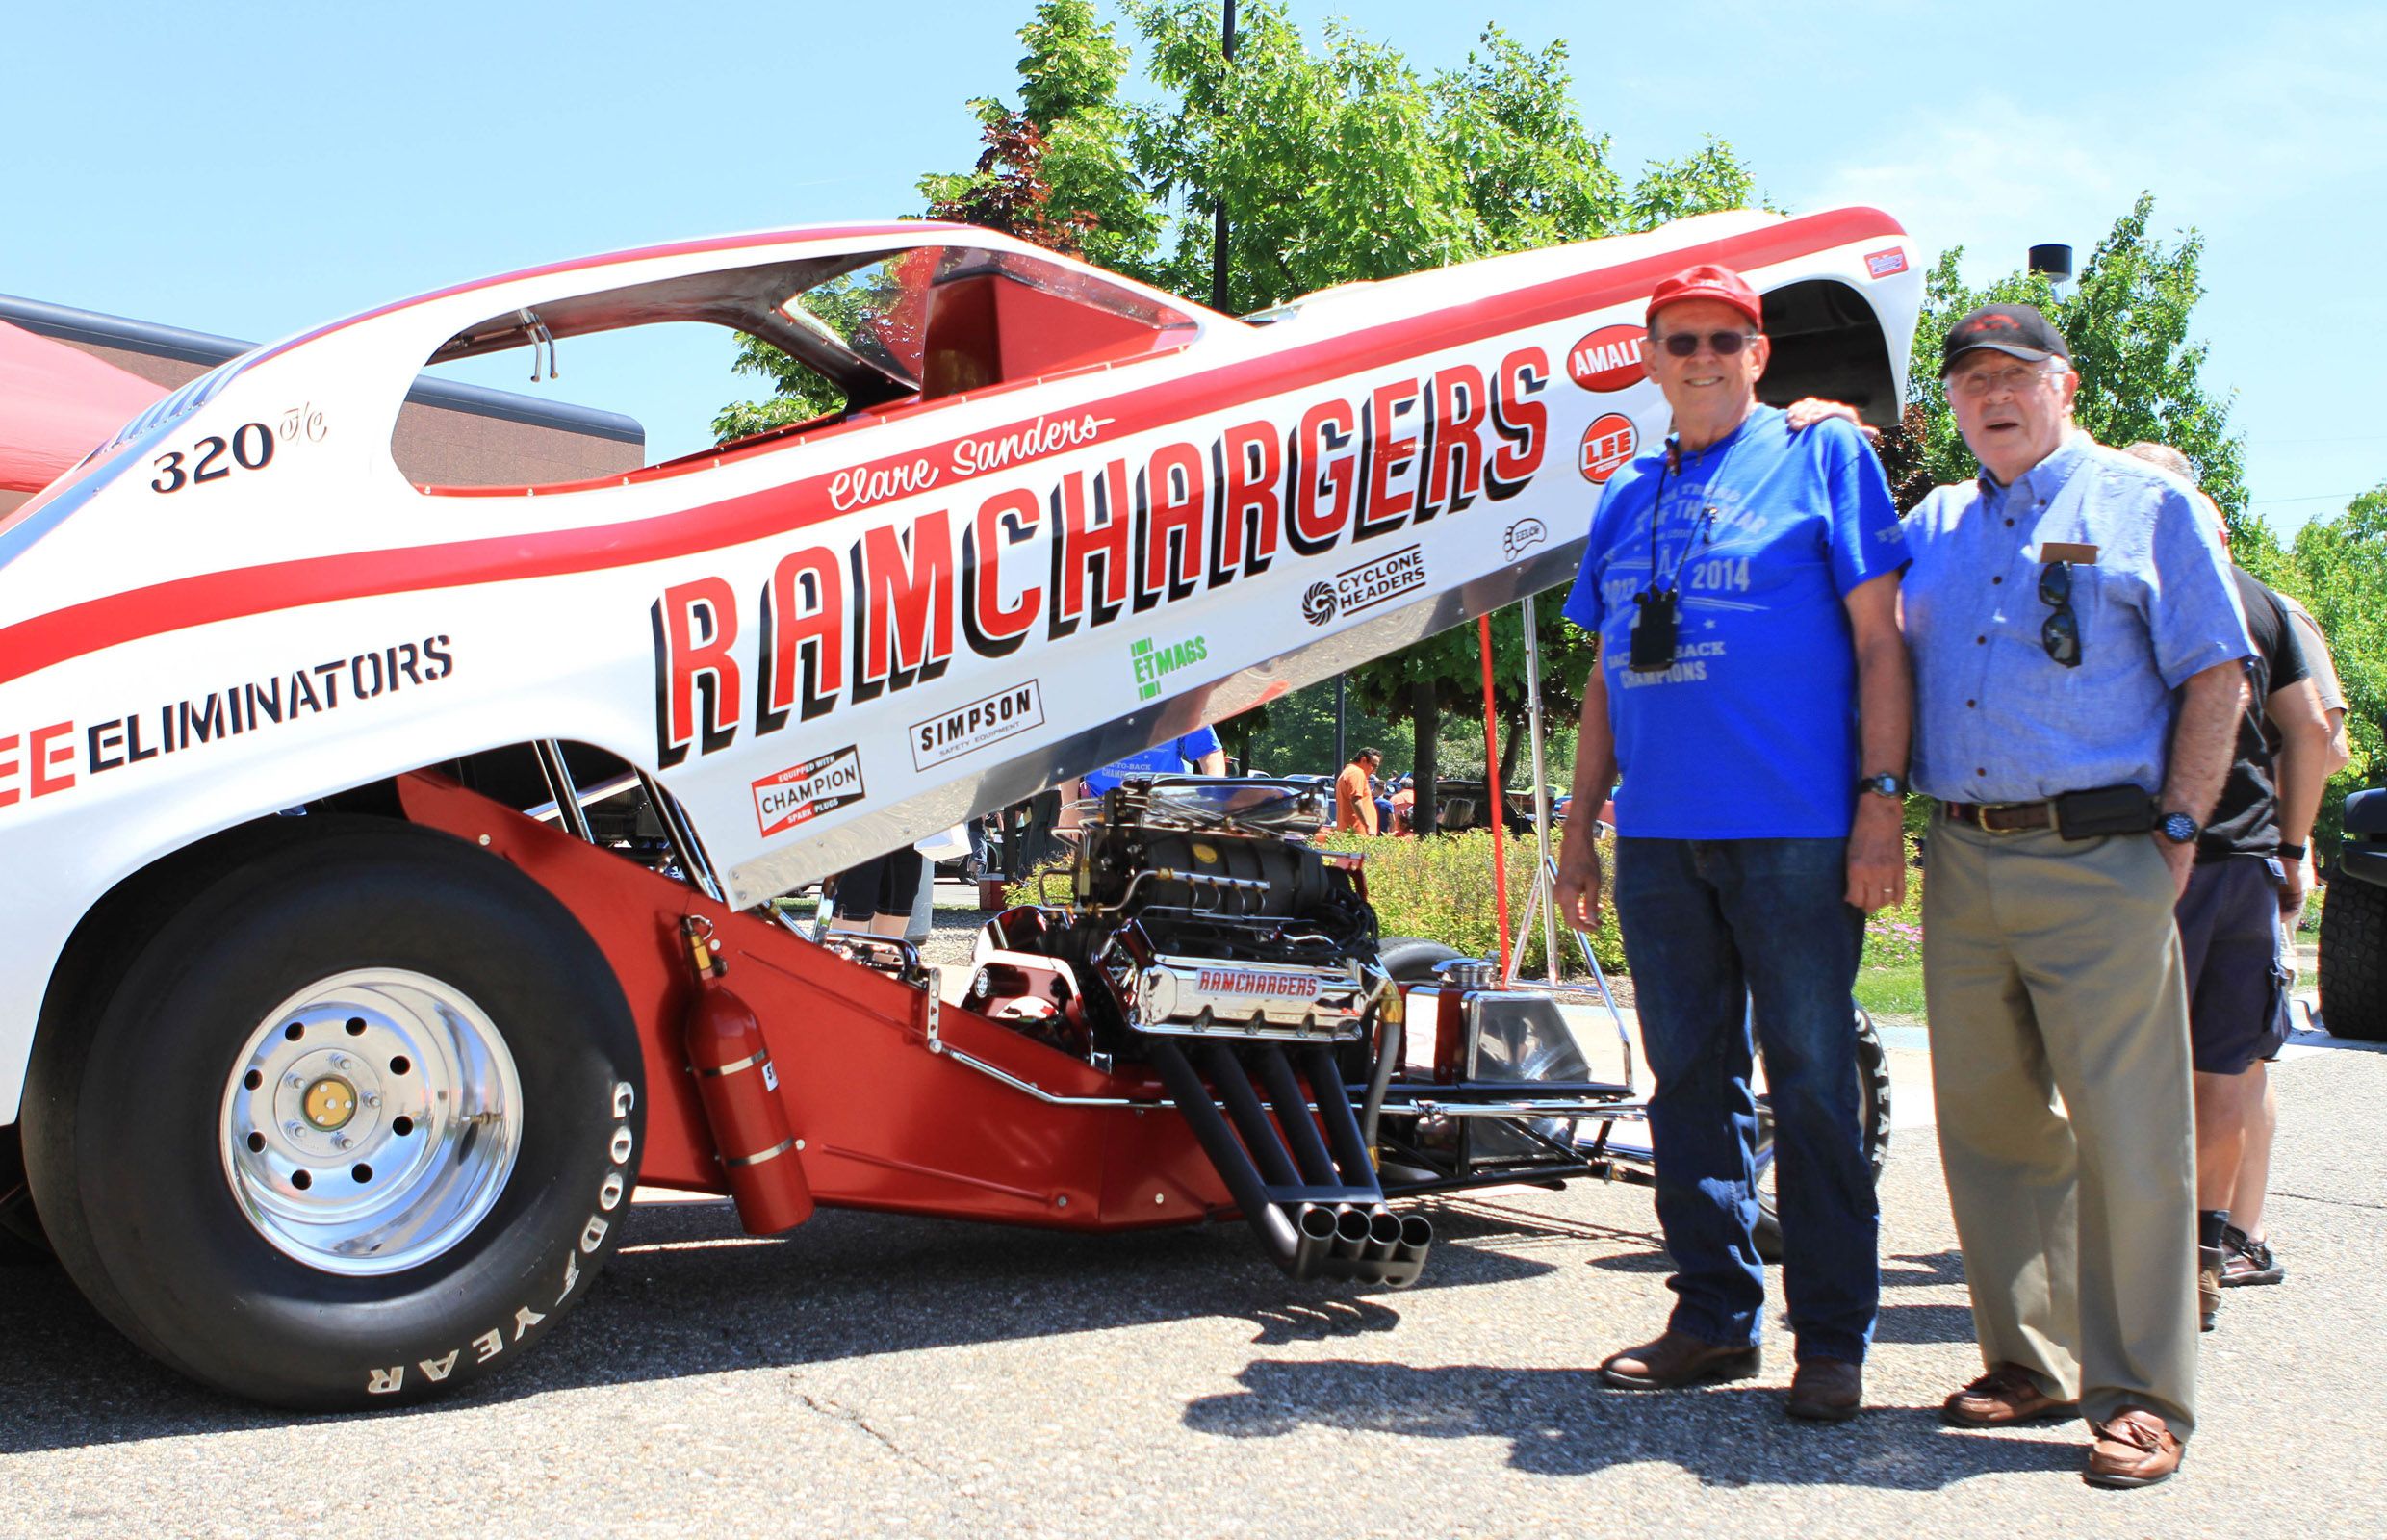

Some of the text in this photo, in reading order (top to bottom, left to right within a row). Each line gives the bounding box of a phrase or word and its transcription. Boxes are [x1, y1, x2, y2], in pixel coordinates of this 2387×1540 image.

[1574, 336, 1647, 377] AMALI
[151, 423, 275, 495] 320
[828, 415, 1116, 511] Clare Sanders
[1586, 431, 1630, 466] LEE
[651, 346, 1550, 770] RAMCHARGERS
[1338, 551, 1424, 593] CYCLONE
[1691, 556, 1751, 593] 2014
[1340, 567, 1425, 610] HEADERS
[88, 635, 453, 775] ELIMINATORS
[921, 689, 1031, 752] SIMPSON
[939, 721, 1020, 757] SAFETY EQUIPMENT
[762, 765, 857, 814] CHAMPION
[778, 755, 836, 783] EQUIPPED WITH
[787, 798, 839, 824] SPARK PLUGS
[1198, 971, 1318, 998] RAMCHARGERS
[367, 1081, 634, 1395] GOODYEAR
